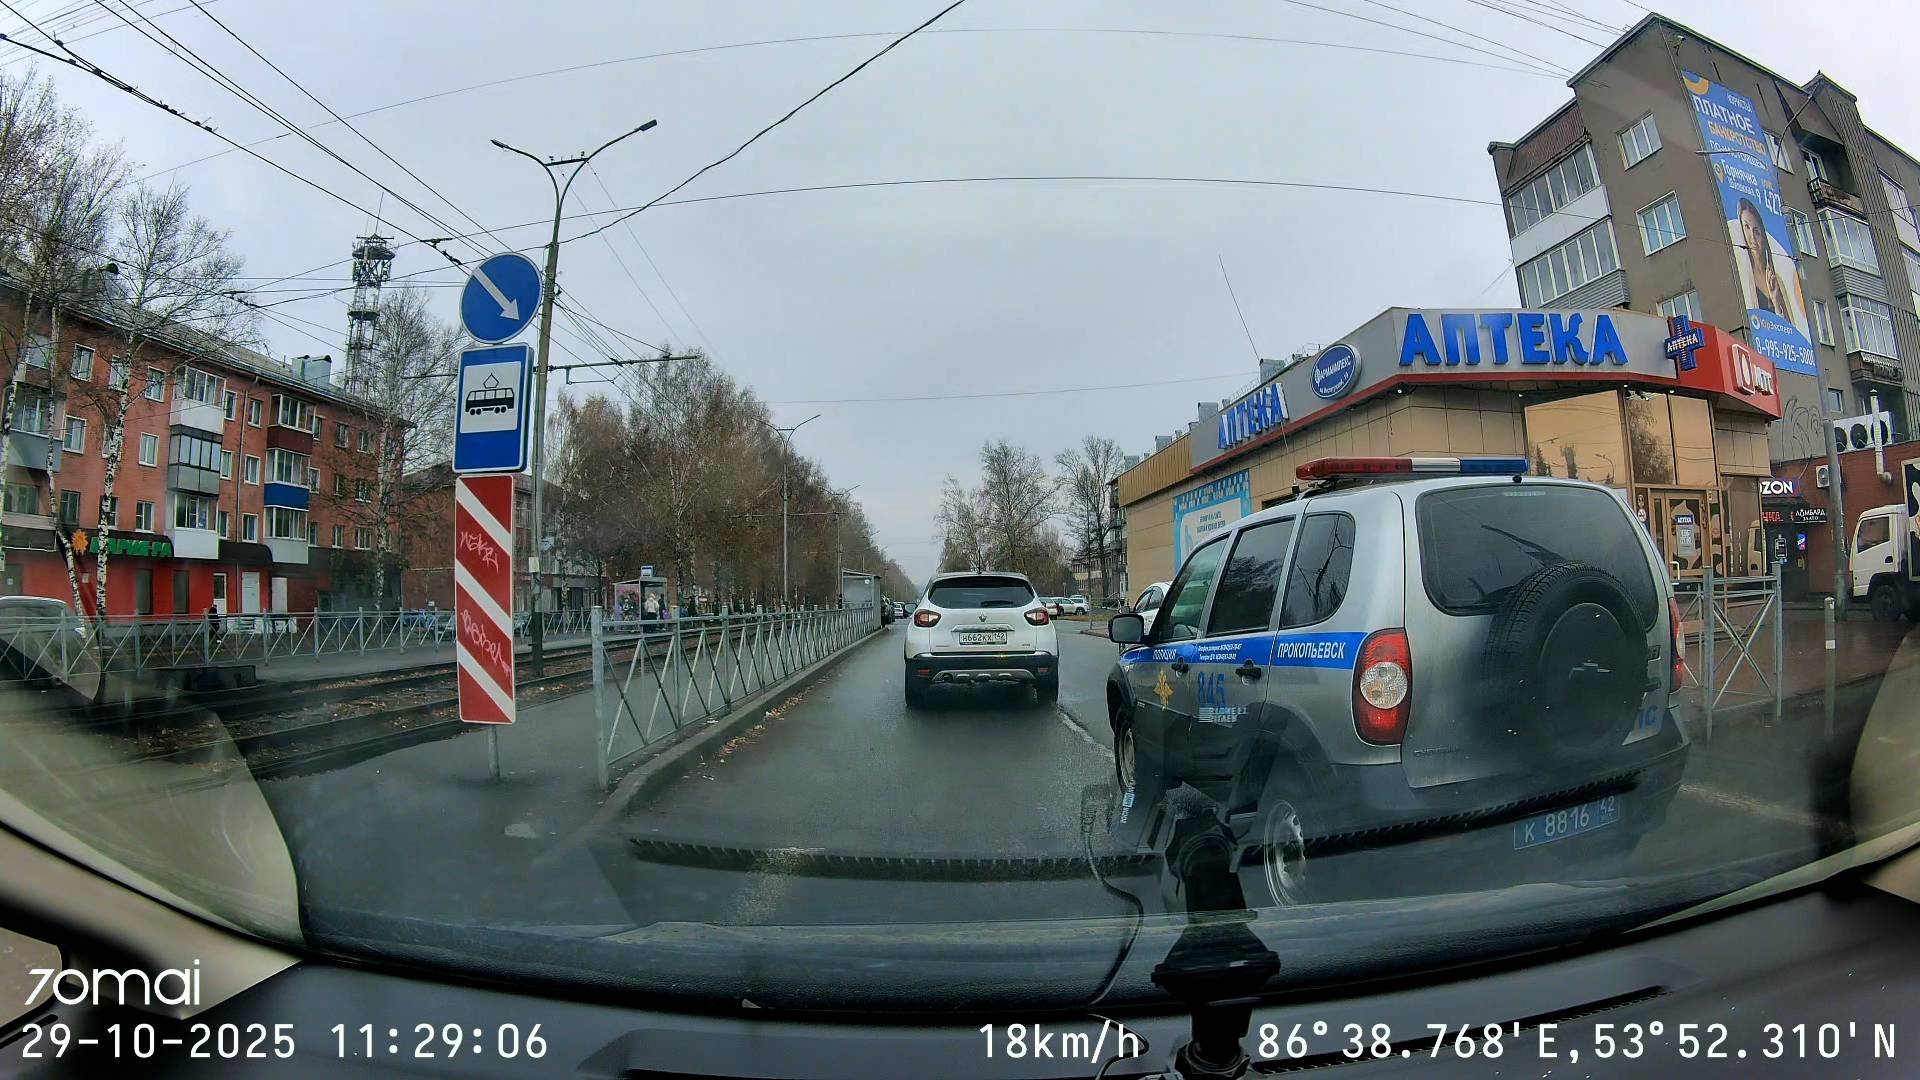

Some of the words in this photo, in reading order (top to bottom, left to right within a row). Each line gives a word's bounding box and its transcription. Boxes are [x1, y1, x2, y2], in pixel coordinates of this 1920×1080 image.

[1692, 94, 1755, 135] ПЛАТНОЕ
[1708, 120, 1767, 155] БАНКРОТСТВО
[1400, 312, 1629, 366] АПТЕКА
[1667, 333, 1699, 353] АПТЕКА
[1217, 383, 1289, 449] АПТЕКА
[1760, 480, 1794, 495] ZON
[1277, 641, 1347, 659] ПРОКОПЬЕВСК
[1197, 671, 1226, 707] 845
[1524, 822, 1536, 843] К
[1545, 804, 1590, 837] 8816
[1600, 795, 1615, 814] 42
